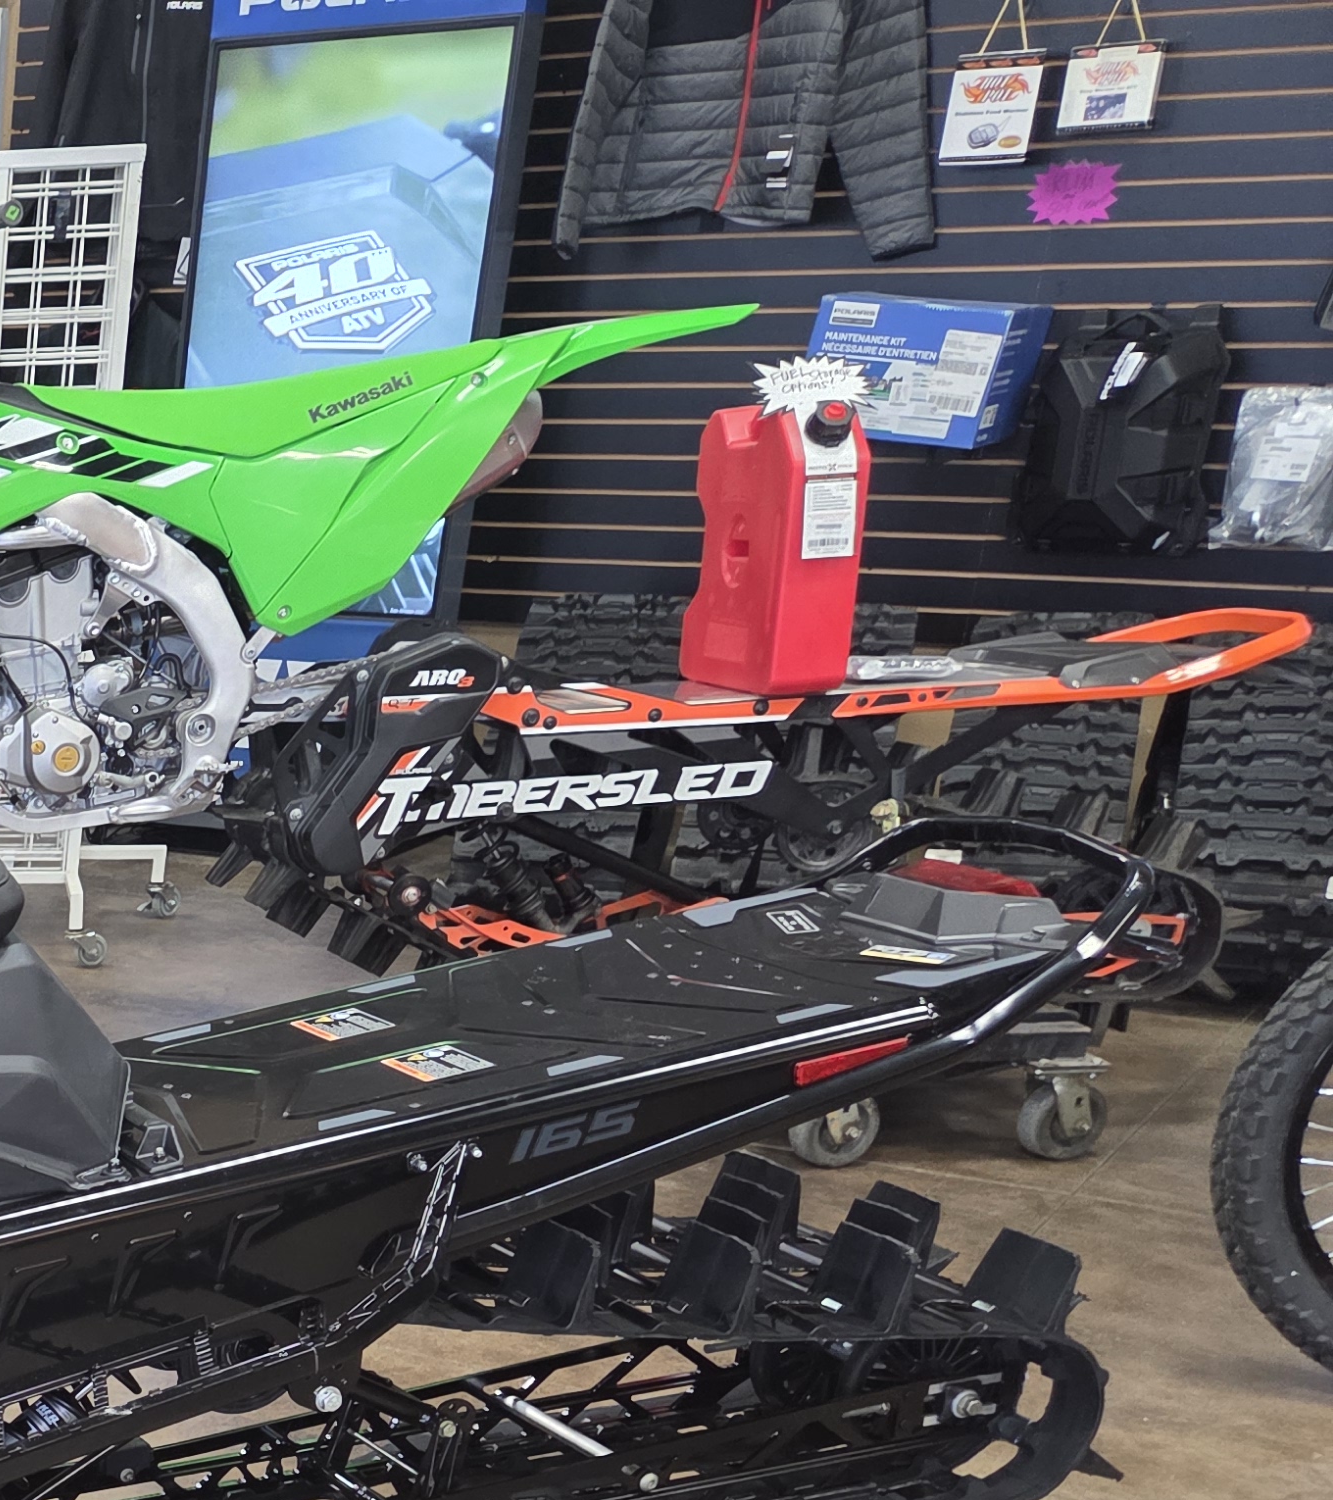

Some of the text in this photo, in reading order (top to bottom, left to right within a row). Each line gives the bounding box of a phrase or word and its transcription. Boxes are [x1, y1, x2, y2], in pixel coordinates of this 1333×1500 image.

[271, 243, 359, 272] POLARIS
[289, 285, 408, 325] ANNIVERSARY OF
[834, 308, 876, 317] POLARIS
[341, 307, 385, 334] ATV
[824, 331, 907, 346] MAINTENANCE KIT
[770, 366, 811, 386] FUEL
[308, 371, 414, 424] Kawasaki
[509, 1099, 641, 1166] 165
